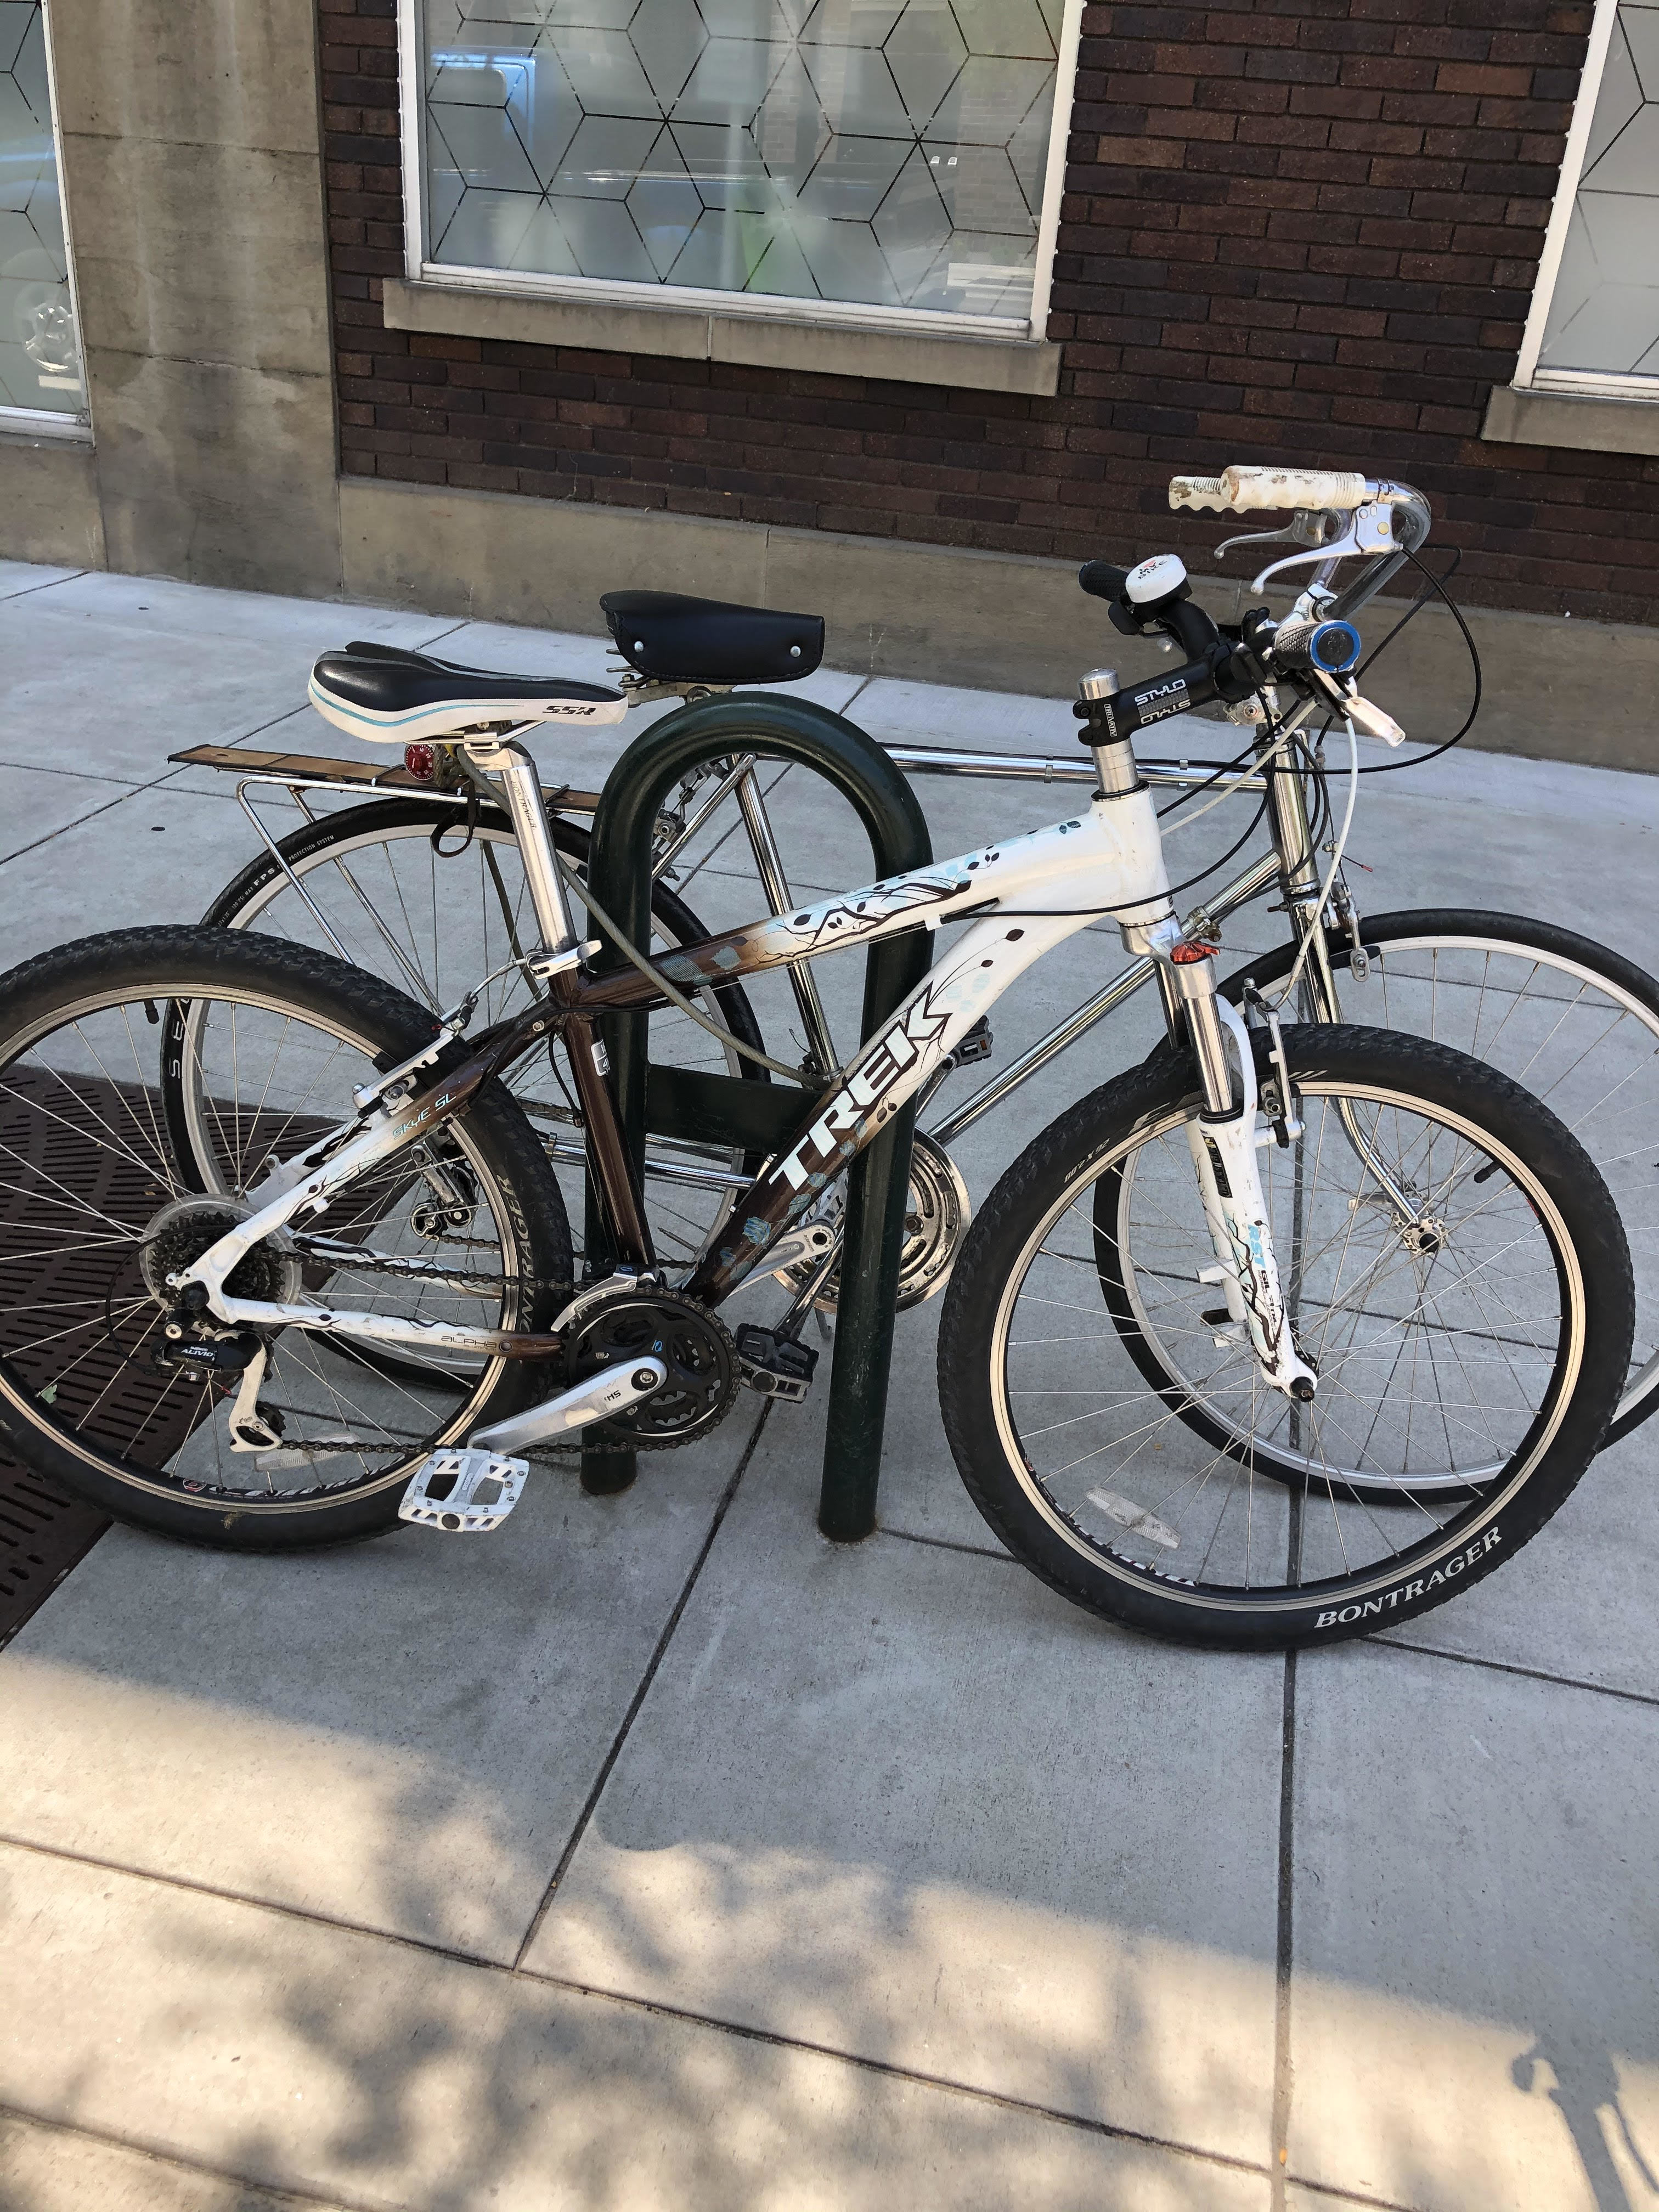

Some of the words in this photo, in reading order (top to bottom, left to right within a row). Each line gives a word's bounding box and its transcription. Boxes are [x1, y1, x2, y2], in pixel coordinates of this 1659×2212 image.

[542, 705, 597, 715] SSR
[1134, 679, 1186, 706] STYLO
[1104, 704, 1118, 737] TRUVATIV
[244, 887, 254, 896] MAX
[253, 867, 275, 887] FPS
[288, 843, 315, 861] PROTECTION
[317, 834, 335, 846] SYSTEM
[768, 980, 953, 1191] TREK
[392, 1106, 431, 1140] SKYE
[435, 1093, 456, 1111] SL
[1248, 1224, 1266, 1269] RST
[180, 1348, 214, 1357] ALIVIO
[1313, 1526, 1503, 1629] BONTRAGER
